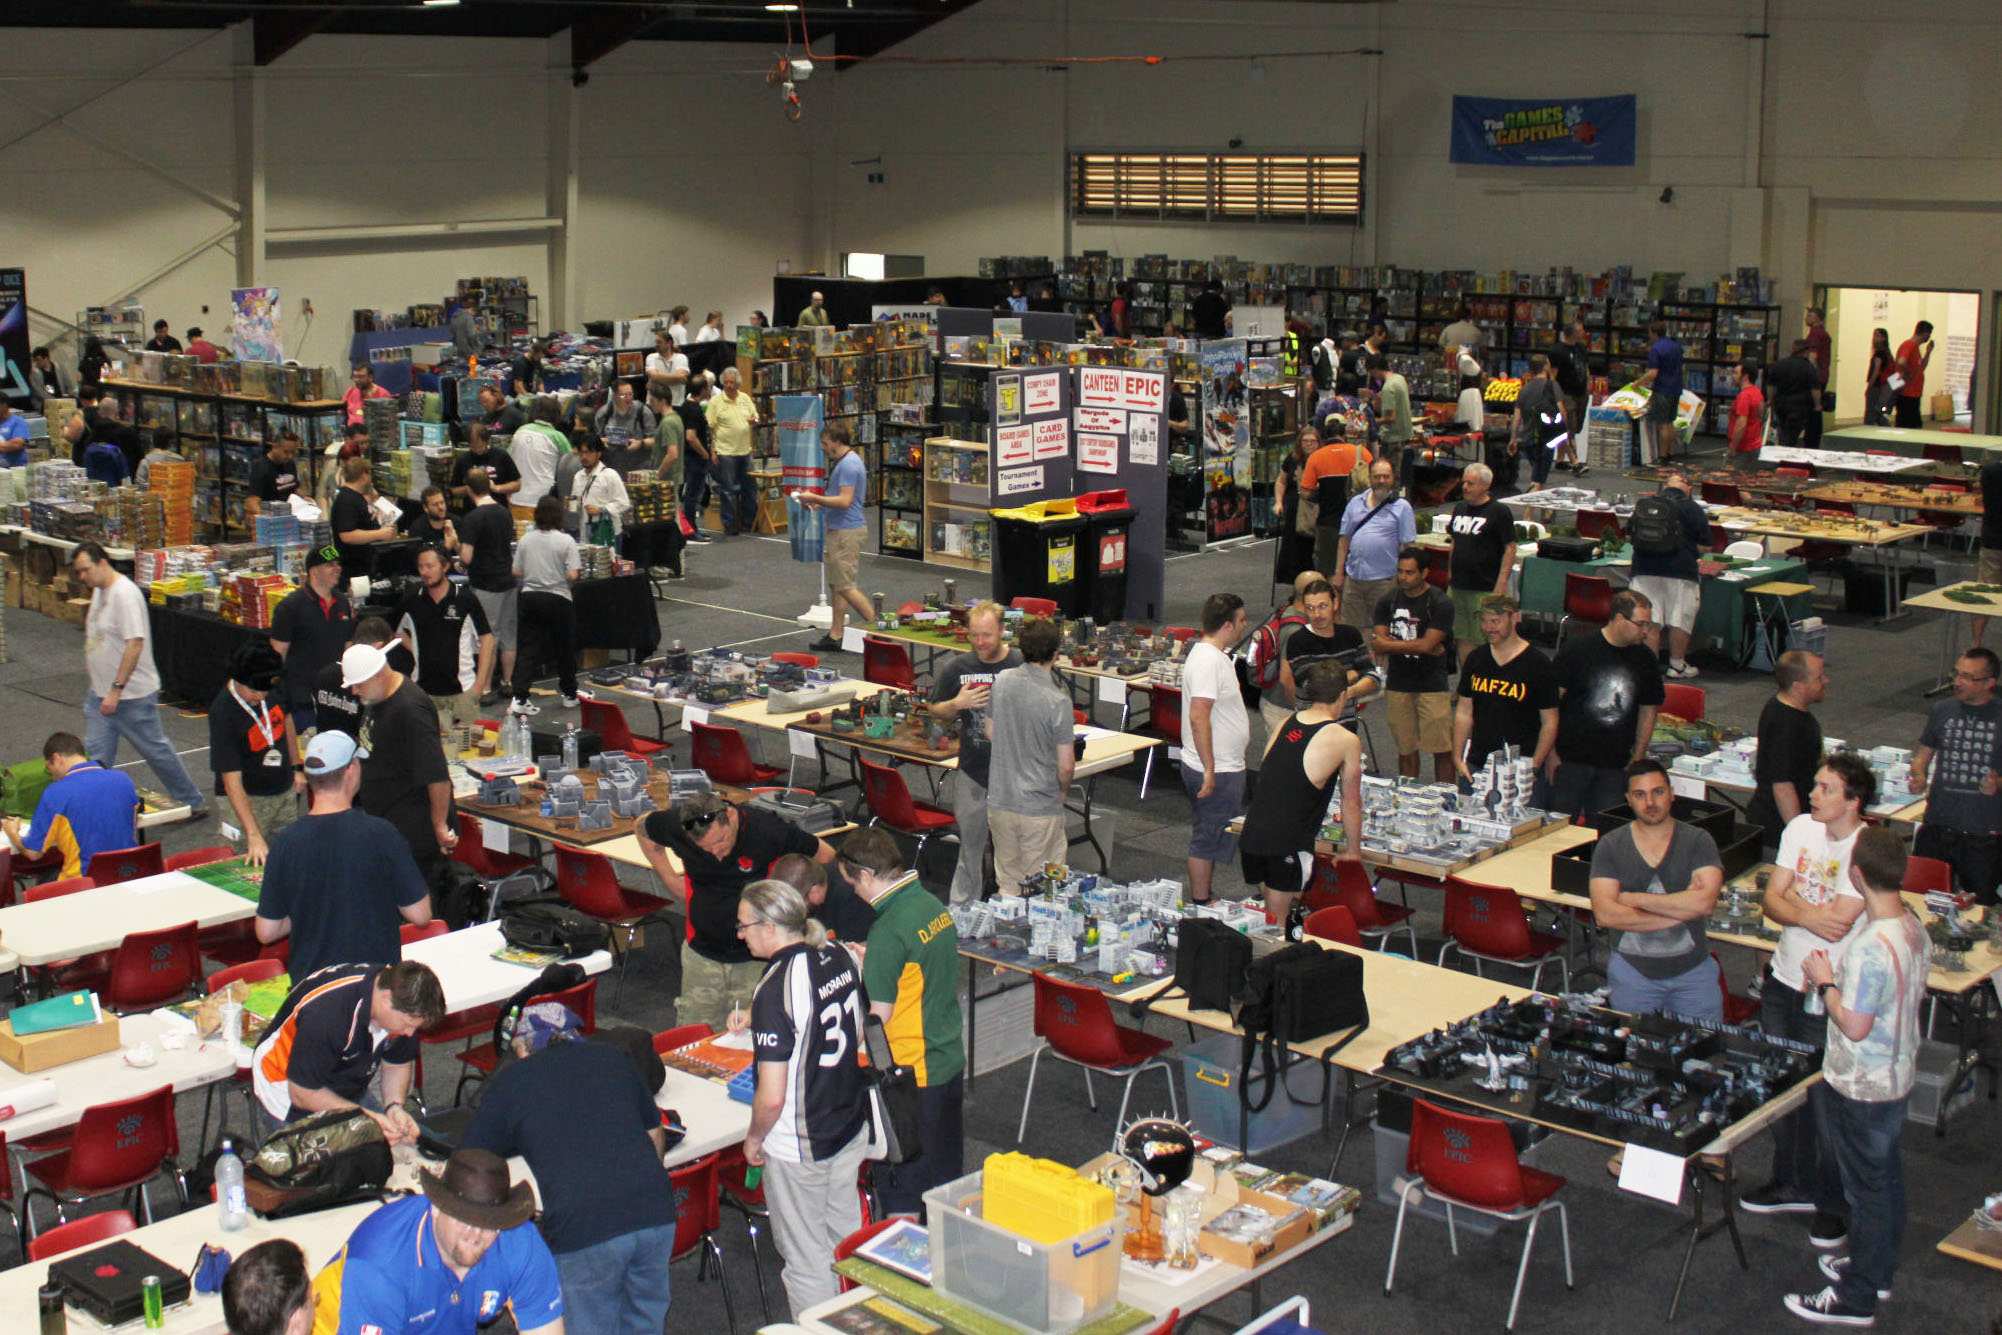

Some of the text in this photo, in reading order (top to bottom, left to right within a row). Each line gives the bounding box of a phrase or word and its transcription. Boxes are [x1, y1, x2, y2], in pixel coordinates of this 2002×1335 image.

[1083, 374, 1120, 393] CANTEEN
[1125, 377, 1161, 397] EPIC
[1039, 423, 1064, 434] CARD
[1035, 432, 1067, 444] GAMES
[1000, 469, 1038, 481] Tournament
[1007, 482, 1030, 491] Games
[756, 1032, 778, 1048] VIC
